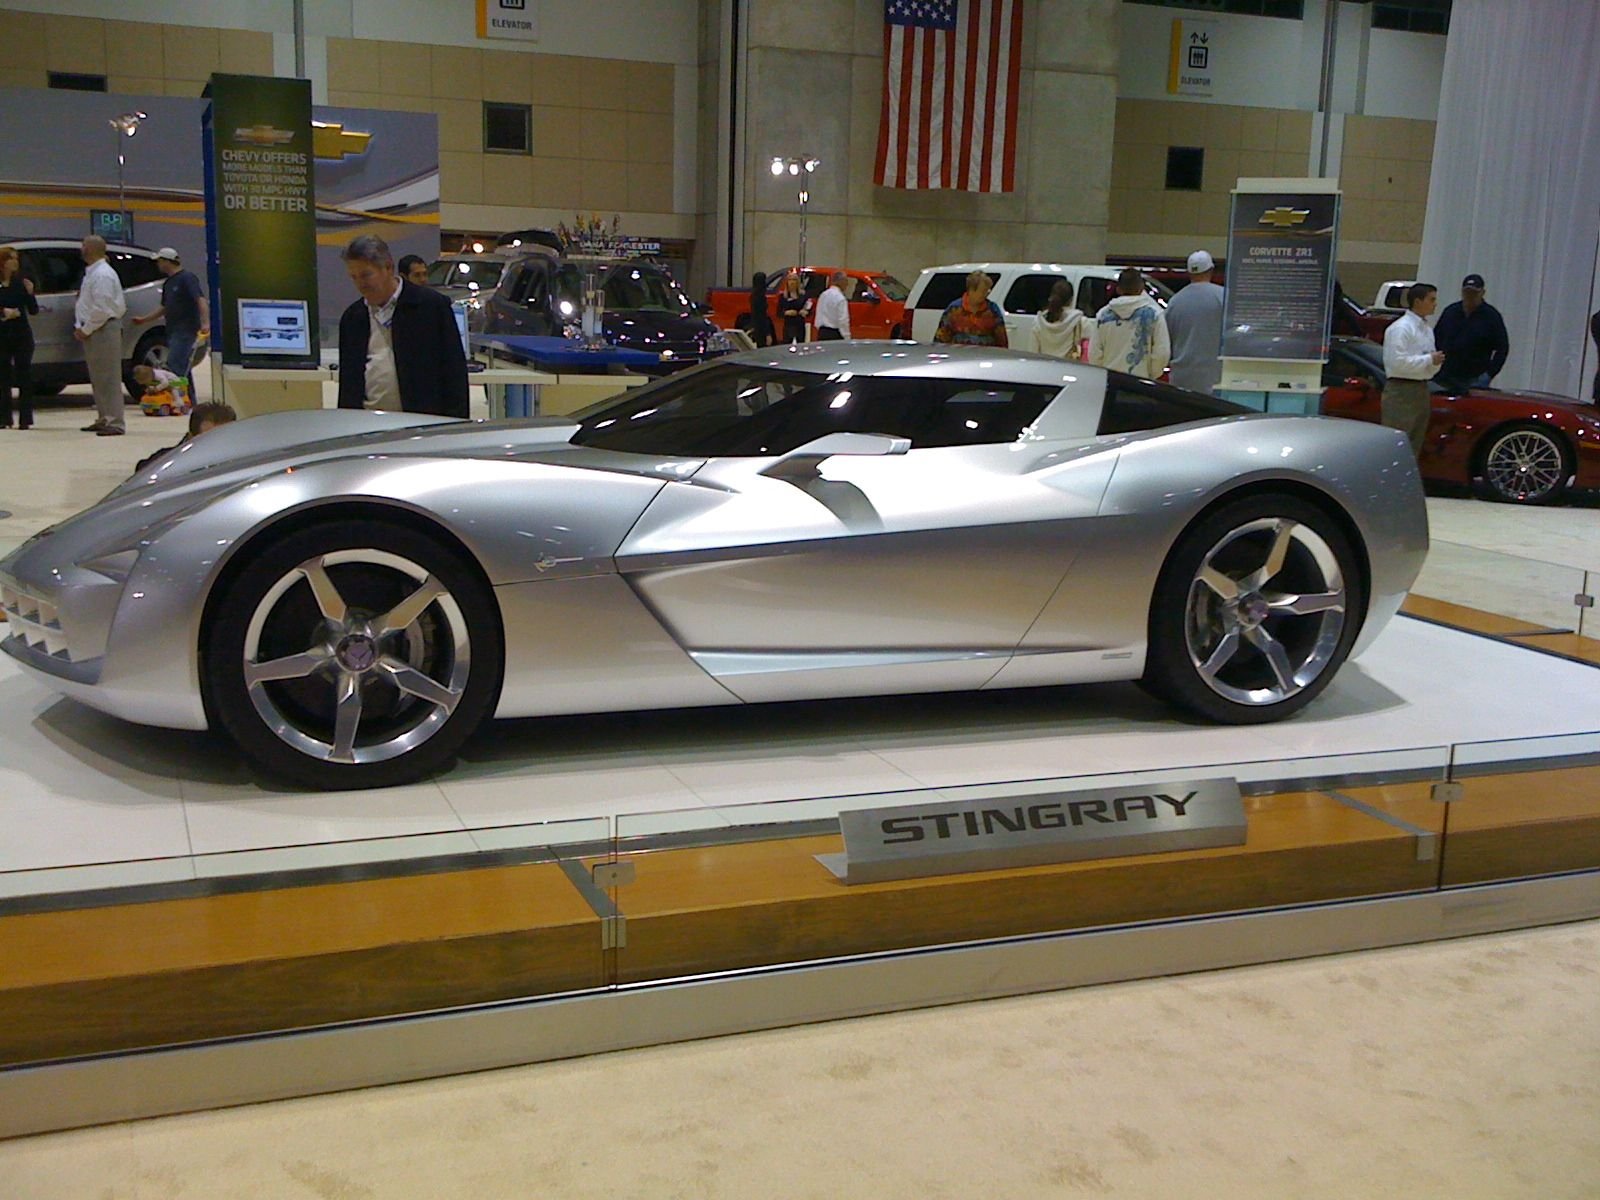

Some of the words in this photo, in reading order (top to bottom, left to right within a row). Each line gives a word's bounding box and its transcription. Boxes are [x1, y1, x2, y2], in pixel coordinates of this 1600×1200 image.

[492, 18, 532, 30] ELEVATOR
[222, 150, 259, 162] CHEVY
[262, 152, 307, 164] OFFERS
[222, 162, 248, 172] MORE
[284, 165, 307, 175] THAN
[223, 172, 258, 183] TOYOTA
[260, 174, 273, 184] OR
[274, 175, 307, 185] HONDA
[223, 183, 249, 193] WITH
[284, 187, 307, 195] HWY
[224, 194, 246, 210] OR
[249, 196, 308, 212] BETTER
[1249, 247, 1292, 256] CORVETTE
[1295, 247, 1313, 257] ZR1
[883, 791, 1198, 844] STINGRAY
